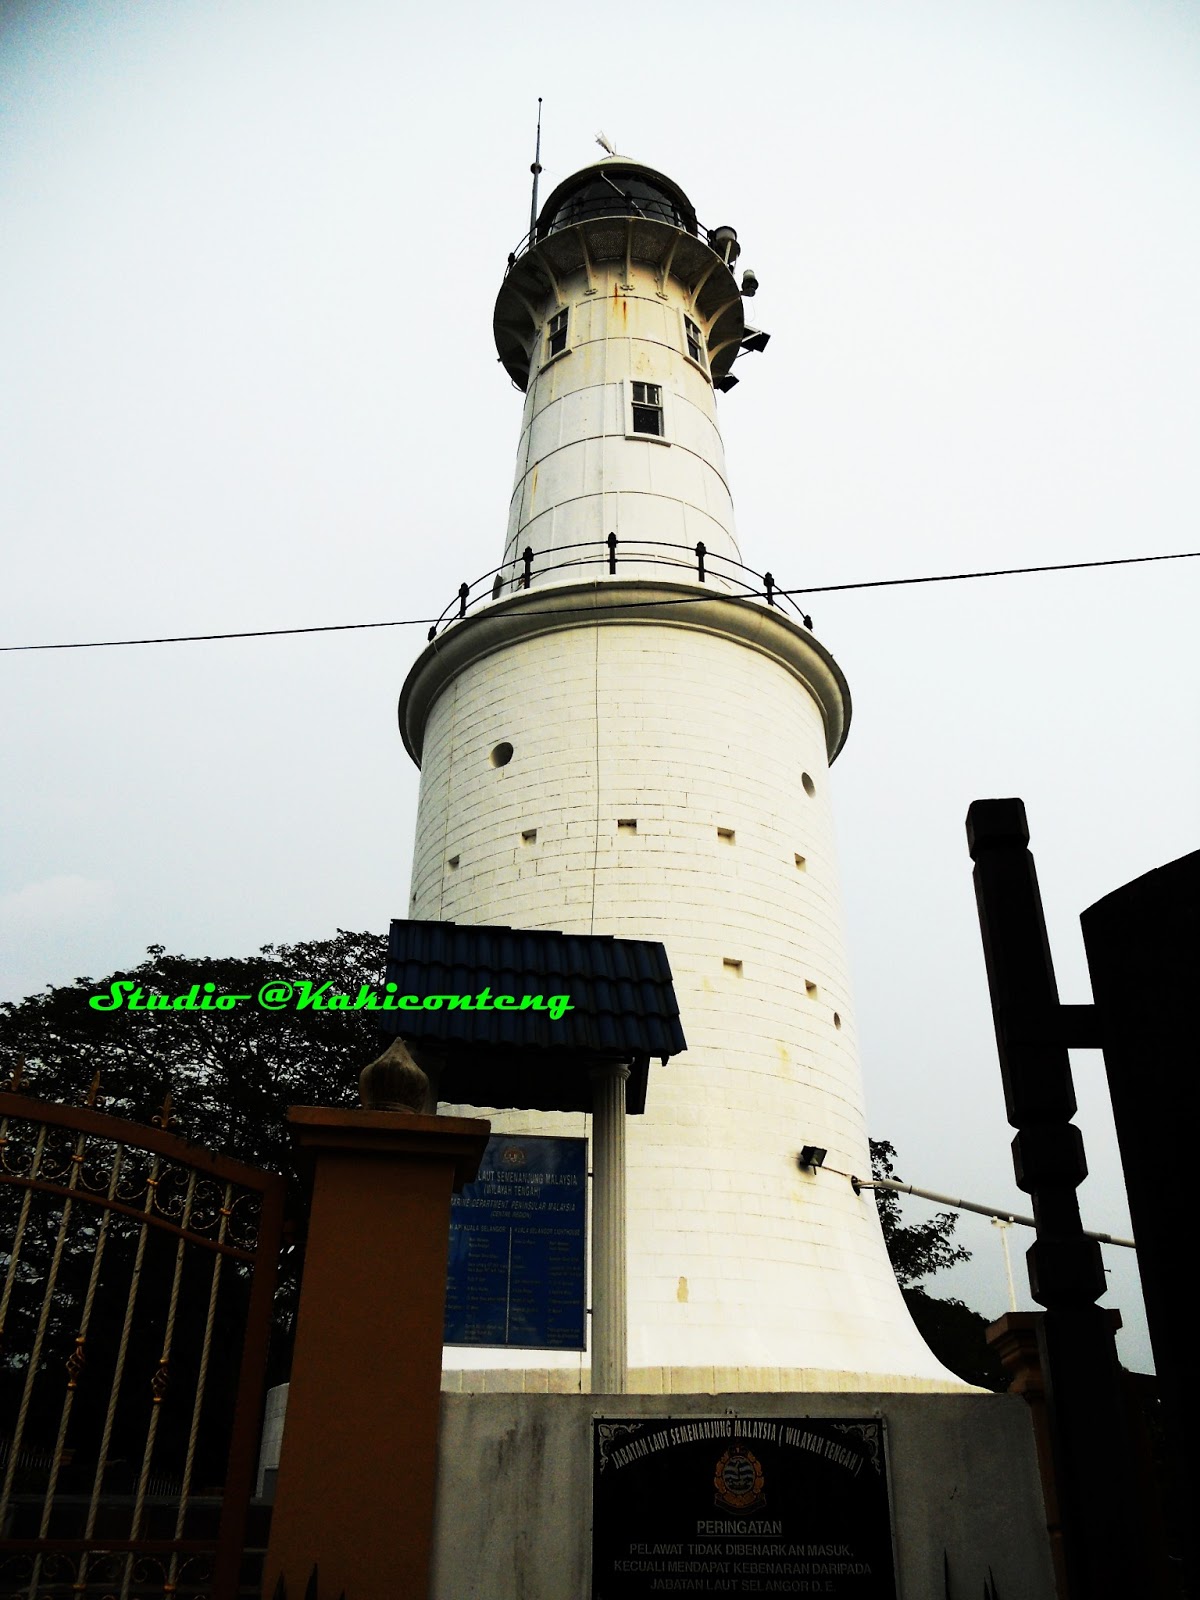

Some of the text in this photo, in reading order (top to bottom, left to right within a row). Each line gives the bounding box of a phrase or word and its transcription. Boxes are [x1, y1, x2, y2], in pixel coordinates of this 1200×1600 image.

[545, 1174, 578, 1186] MALAYSIA
[611, 1438, 649, 1470] JABATAN
[647, 1430, 669, 1452] LAUT
[670, 1420, 732, 1446] SEMENANJUNG
[734, 1419, 776, 1441] MALAYSIA
[785, 1426, 825, 1454] WILAYAH
[824, 1439, 859, 1470] TENGAH
[696, 1520, 783, 1534] PERINGATAN
[629, 1544, 684, 1555] PELAWAT
[687, 1544, 723, 1556] TIDAK
[725, 1544, 805, 1556] DIBENARKAN
[613, 1560, 873, 1575] KECUALI MENDAPAT KEBENARAN DARIPADA
[650, 1578, 704, 1590] JABATAN
[705, 1579, 739, 1591] LAUT
[741, 1580, 809, 1592] SELANGOR
